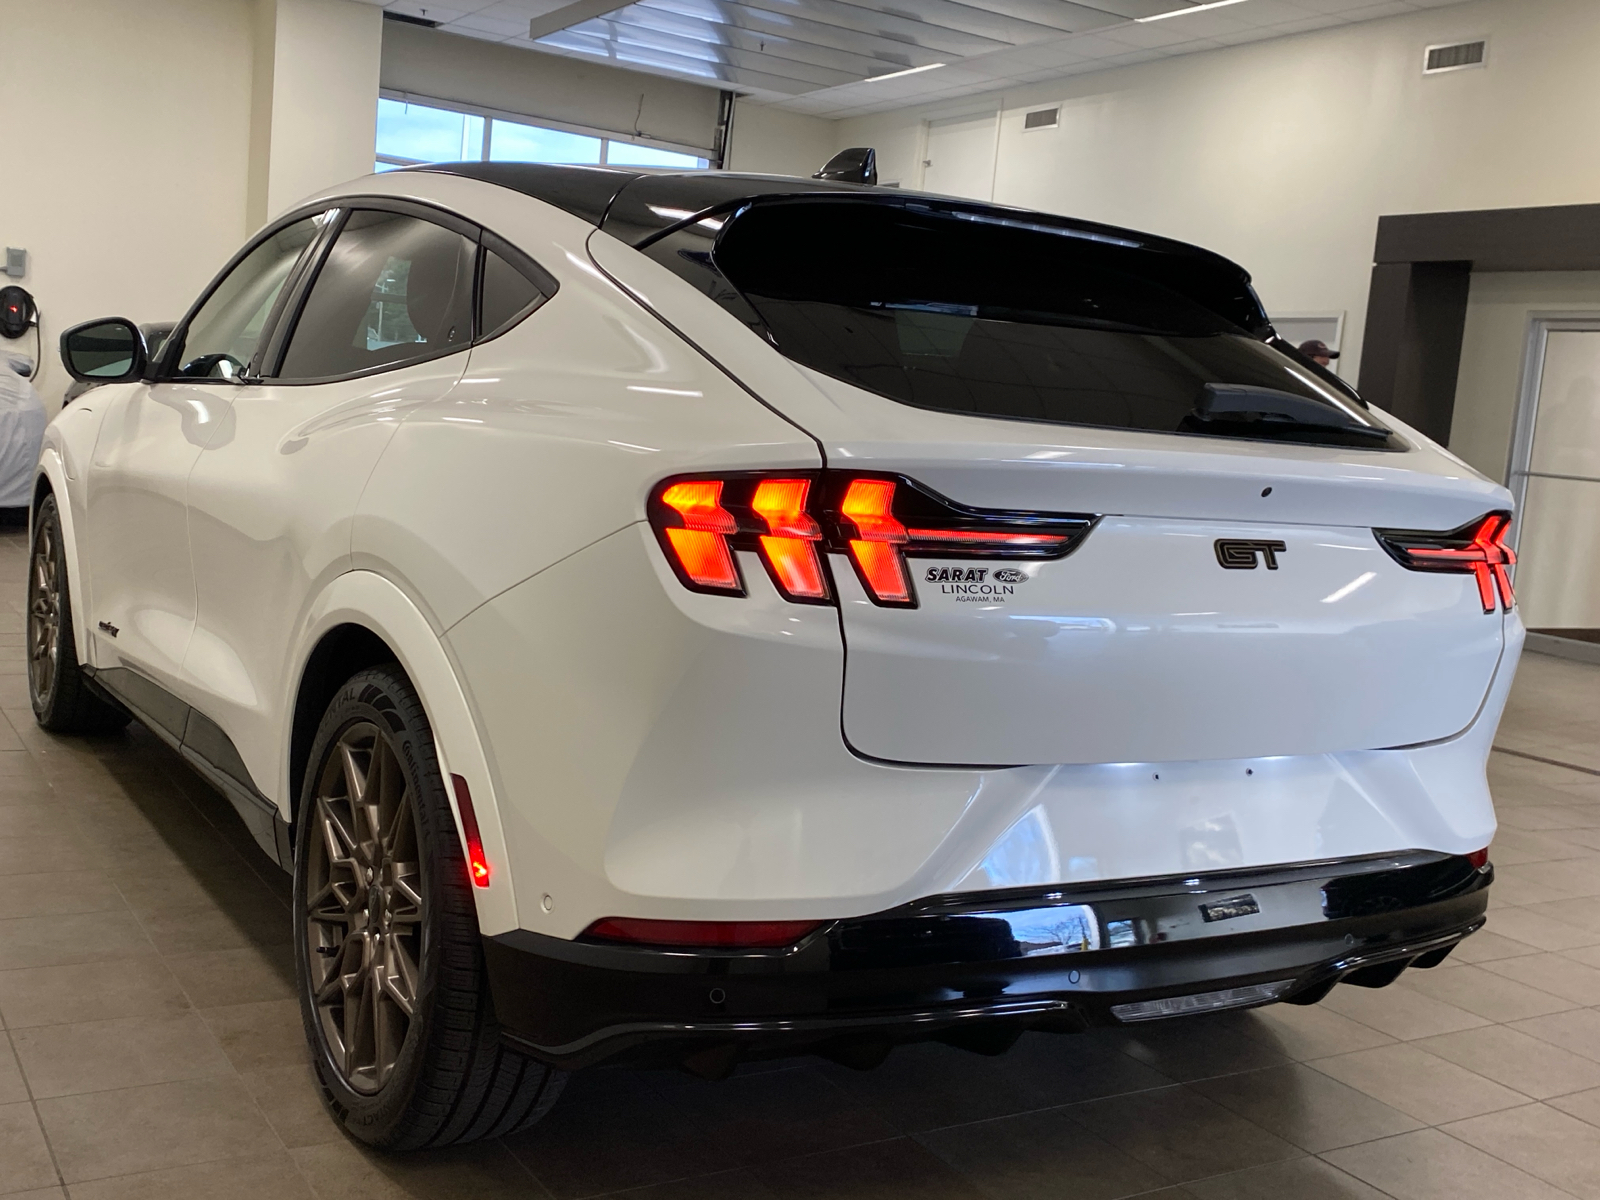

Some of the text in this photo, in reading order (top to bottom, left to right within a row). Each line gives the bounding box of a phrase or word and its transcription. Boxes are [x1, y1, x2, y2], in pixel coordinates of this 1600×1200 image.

[1213, 538, 1287, 570] GT
[925, 567, 989, 583] SARAT
[941, 584, 1014, 595] LINCOLN
